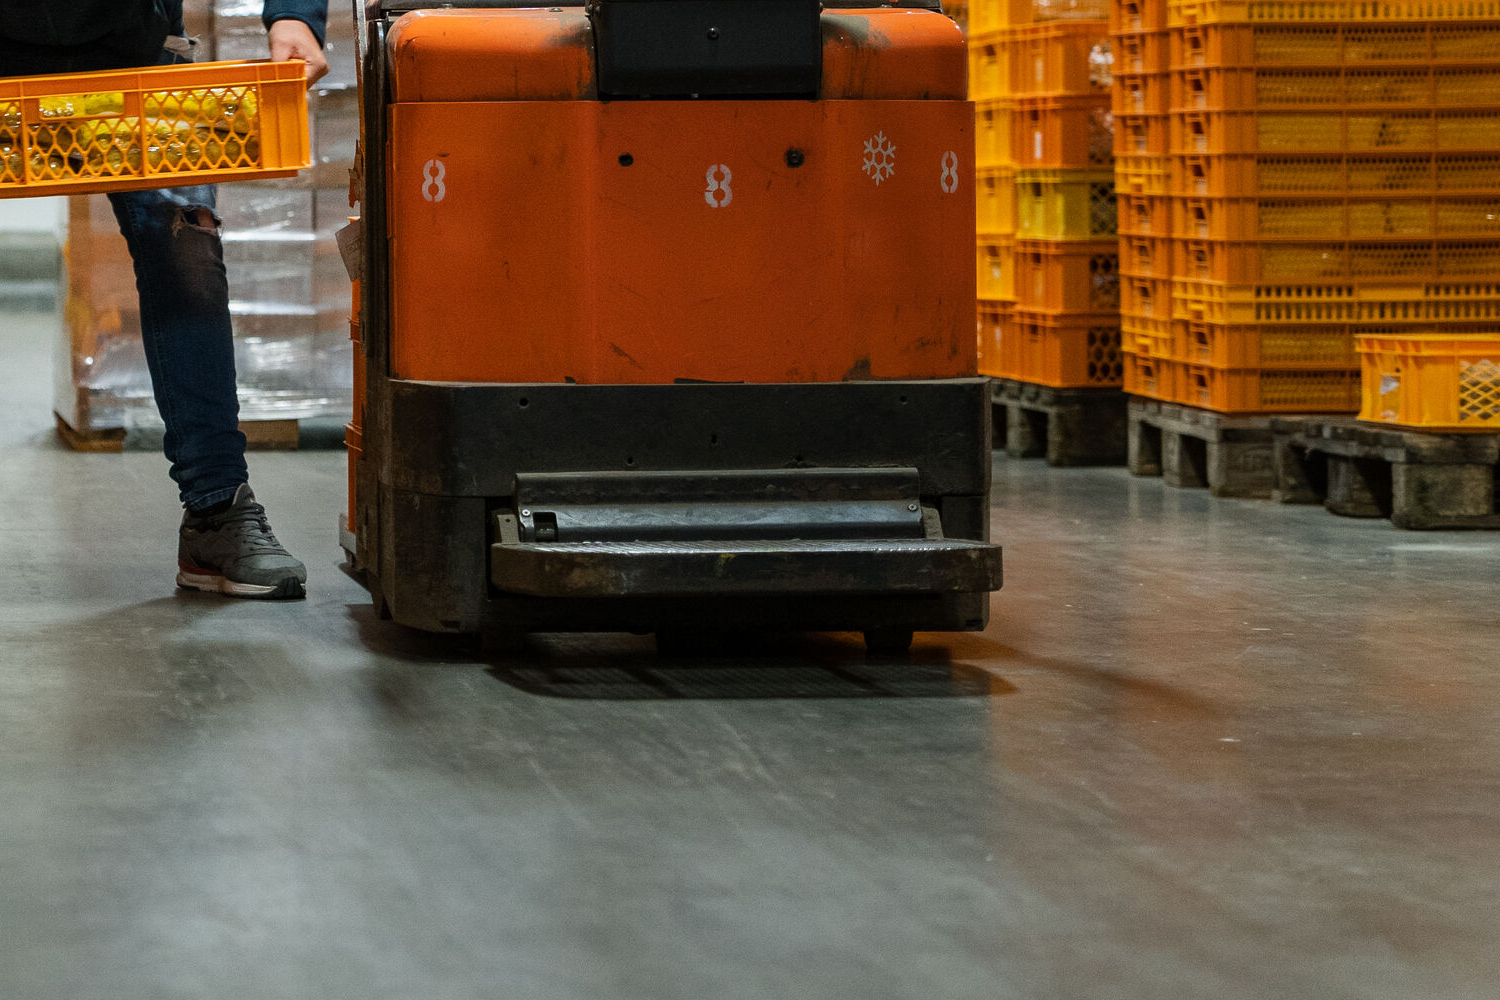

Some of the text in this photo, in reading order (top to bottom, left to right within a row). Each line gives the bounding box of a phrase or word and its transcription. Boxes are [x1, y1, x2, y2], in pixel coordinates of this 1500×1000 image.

[421, 159, 446, 202] 8
[705, 163, 733, 208] 8
[940, 150, 958, 194] 8
